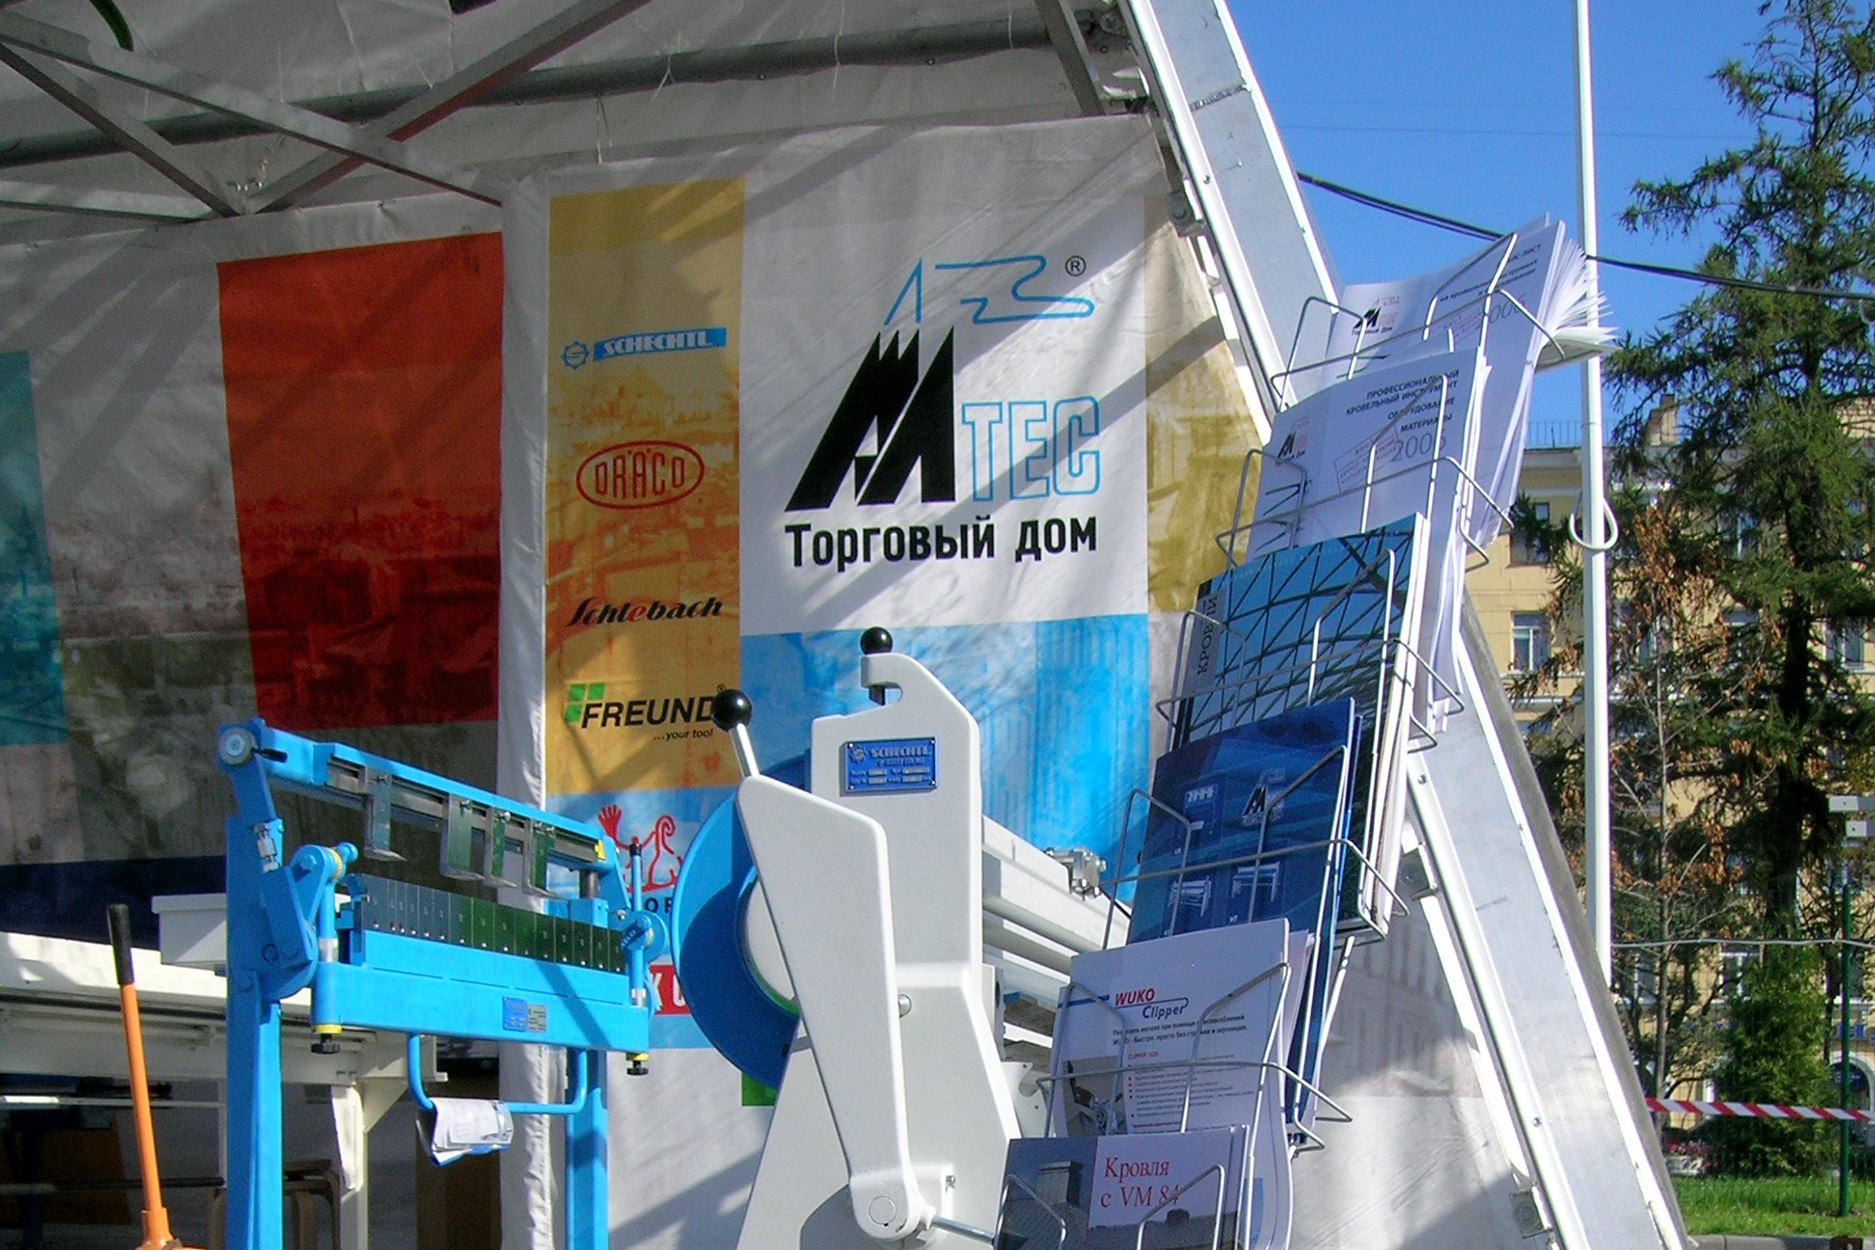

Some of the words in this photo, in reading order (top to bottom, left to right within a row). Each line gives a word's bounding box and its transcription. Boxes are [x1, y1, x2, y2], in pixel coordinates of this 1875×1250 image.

[602, 330, 713, 358] SCHECHTL
[784, 515, 996, 573] Торговый
[1014, 516, 1098, 563] дом
[565, 597, 723, 628] Schlebach
[581, 695, 716, 729] FREUND
[1115, 988, 1156, 1006] WUKO
[1142, 1004, 1186, 1021] Clipper
[1104, 1156, 1171, 1184] Кровля
[1120, 1185, 1154, 1208] VM
